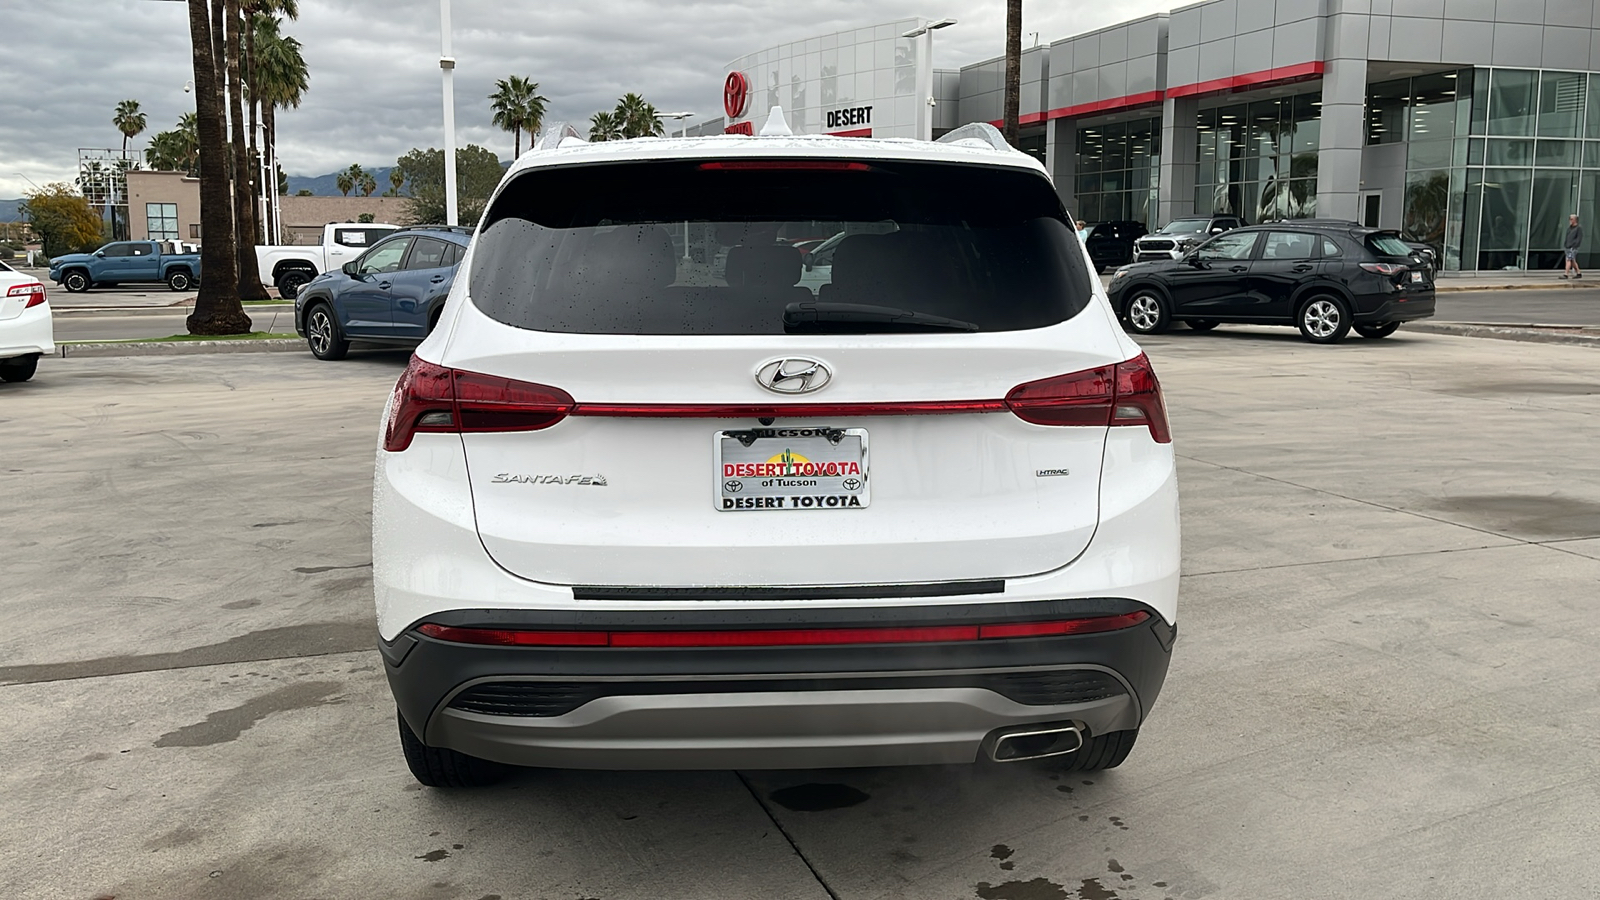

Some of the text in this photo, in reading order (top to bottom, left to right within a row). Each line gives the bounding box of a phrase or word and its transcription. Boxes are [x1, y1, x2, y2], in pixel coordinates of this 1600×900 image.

[827, 106, 873, 128] DESERT
[724, 462, 860, 477] DESERT TOYOTA
[761, 478, 817, 487] of Tucson
[723, 496, 861, 509] DESERT TOYOTA
